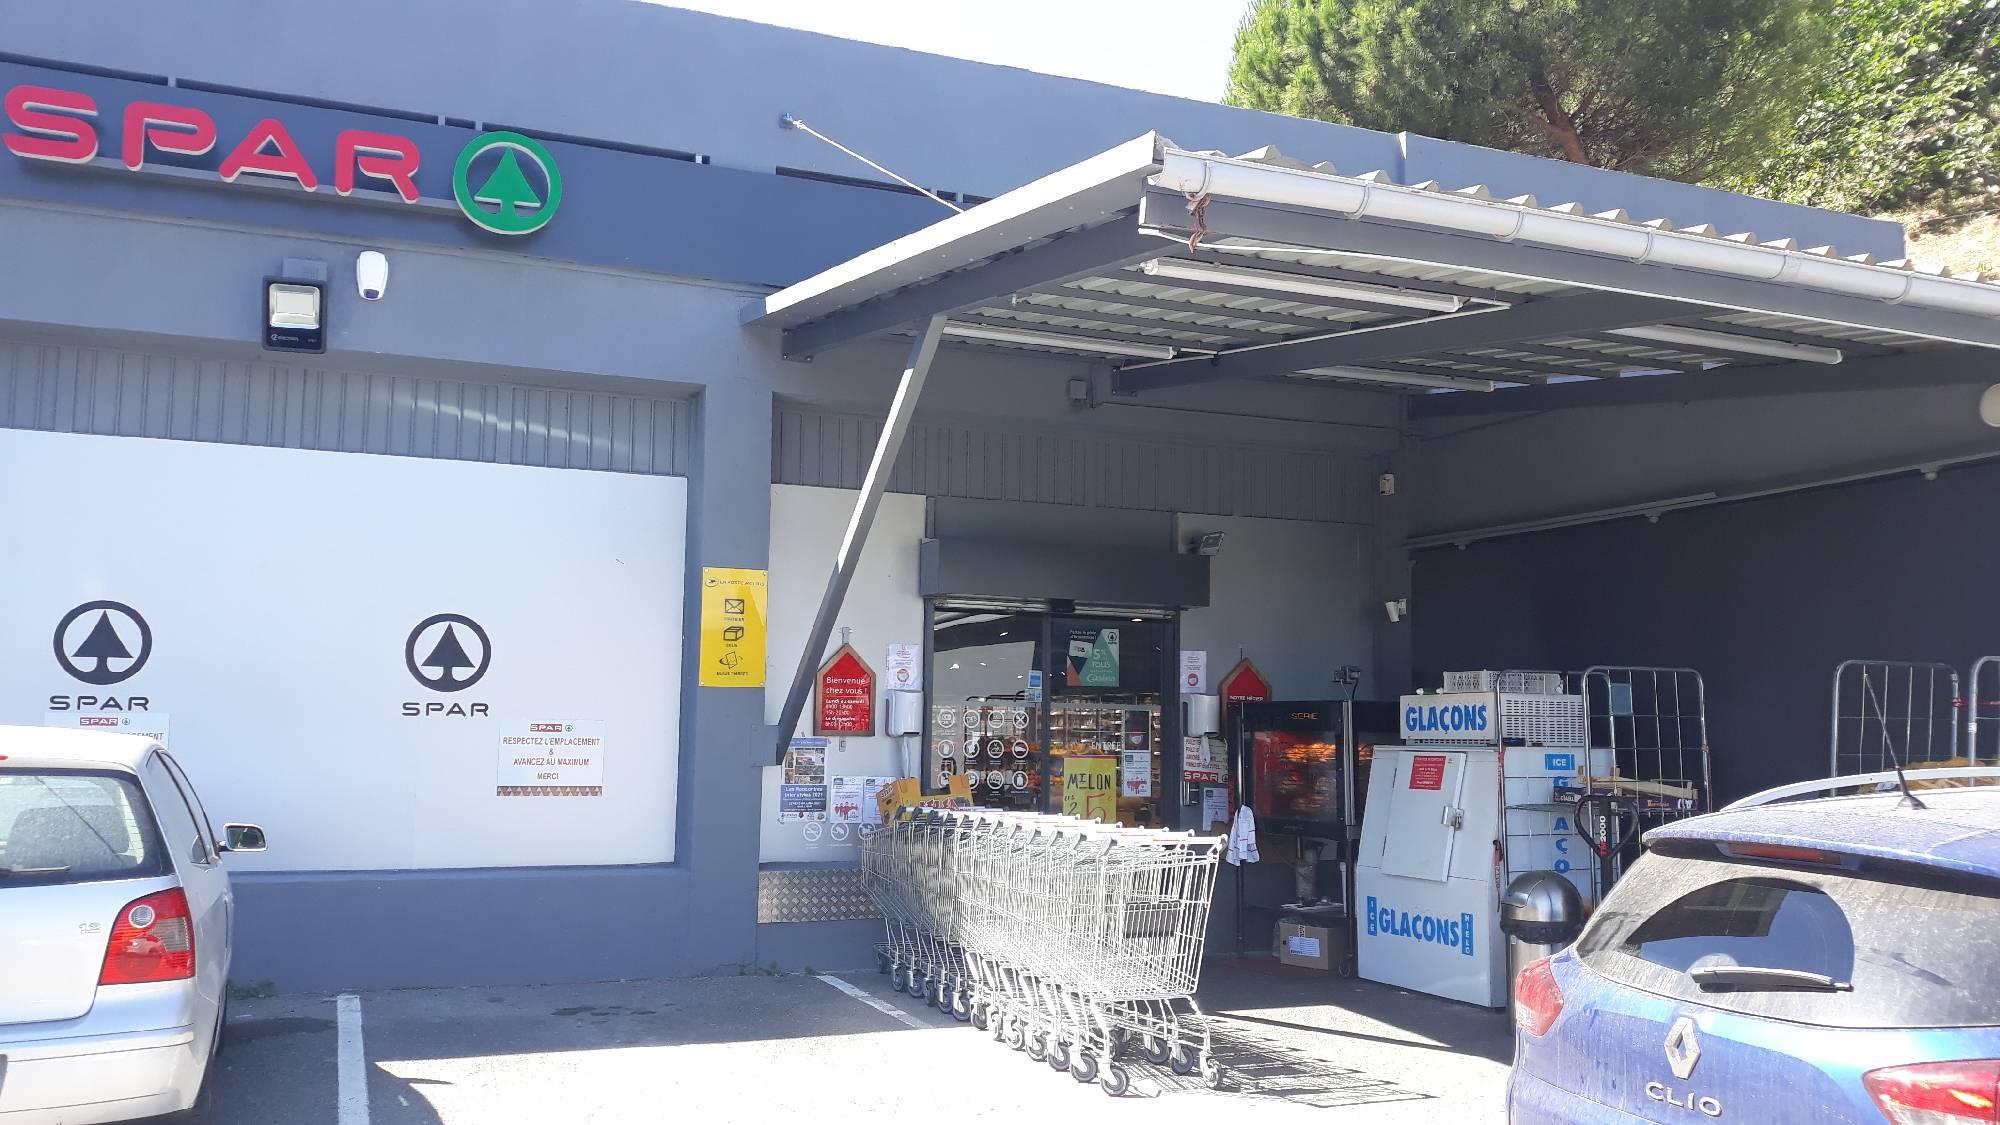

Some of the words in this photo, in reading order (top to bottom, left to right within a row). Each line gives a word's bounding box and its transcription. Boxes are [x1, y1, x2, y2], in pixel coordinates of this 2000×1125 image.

[2, 84, 421, 204] SPAR
[826, 676, 865, 685] Bienvenue
[49, 695, 149, 711] SPAR
[401, 702, 489, 717] SPAR
[80, 718, 118, 726] SPAR
[1406, 704, 1487, 734] GLAÇONS
[503, 736, 543, 745] RESPECTEZ
[545, 738, 600, 746] L'EMPLACEMENT
[513, 758, 545, 766] AVANCEZ
[546, 758, 556, 766] AU
[557, 758, 590, 766] MAXIMUM
[1552, 759, 1567, 767] ICE
[537, 772, 559, 780] MERCI
[1184, 771, 1218, 782] SPAR
[1379, 907, 1460, 947] GLAÇONS
[1646, 1082, 1722, 1117] CLIO
